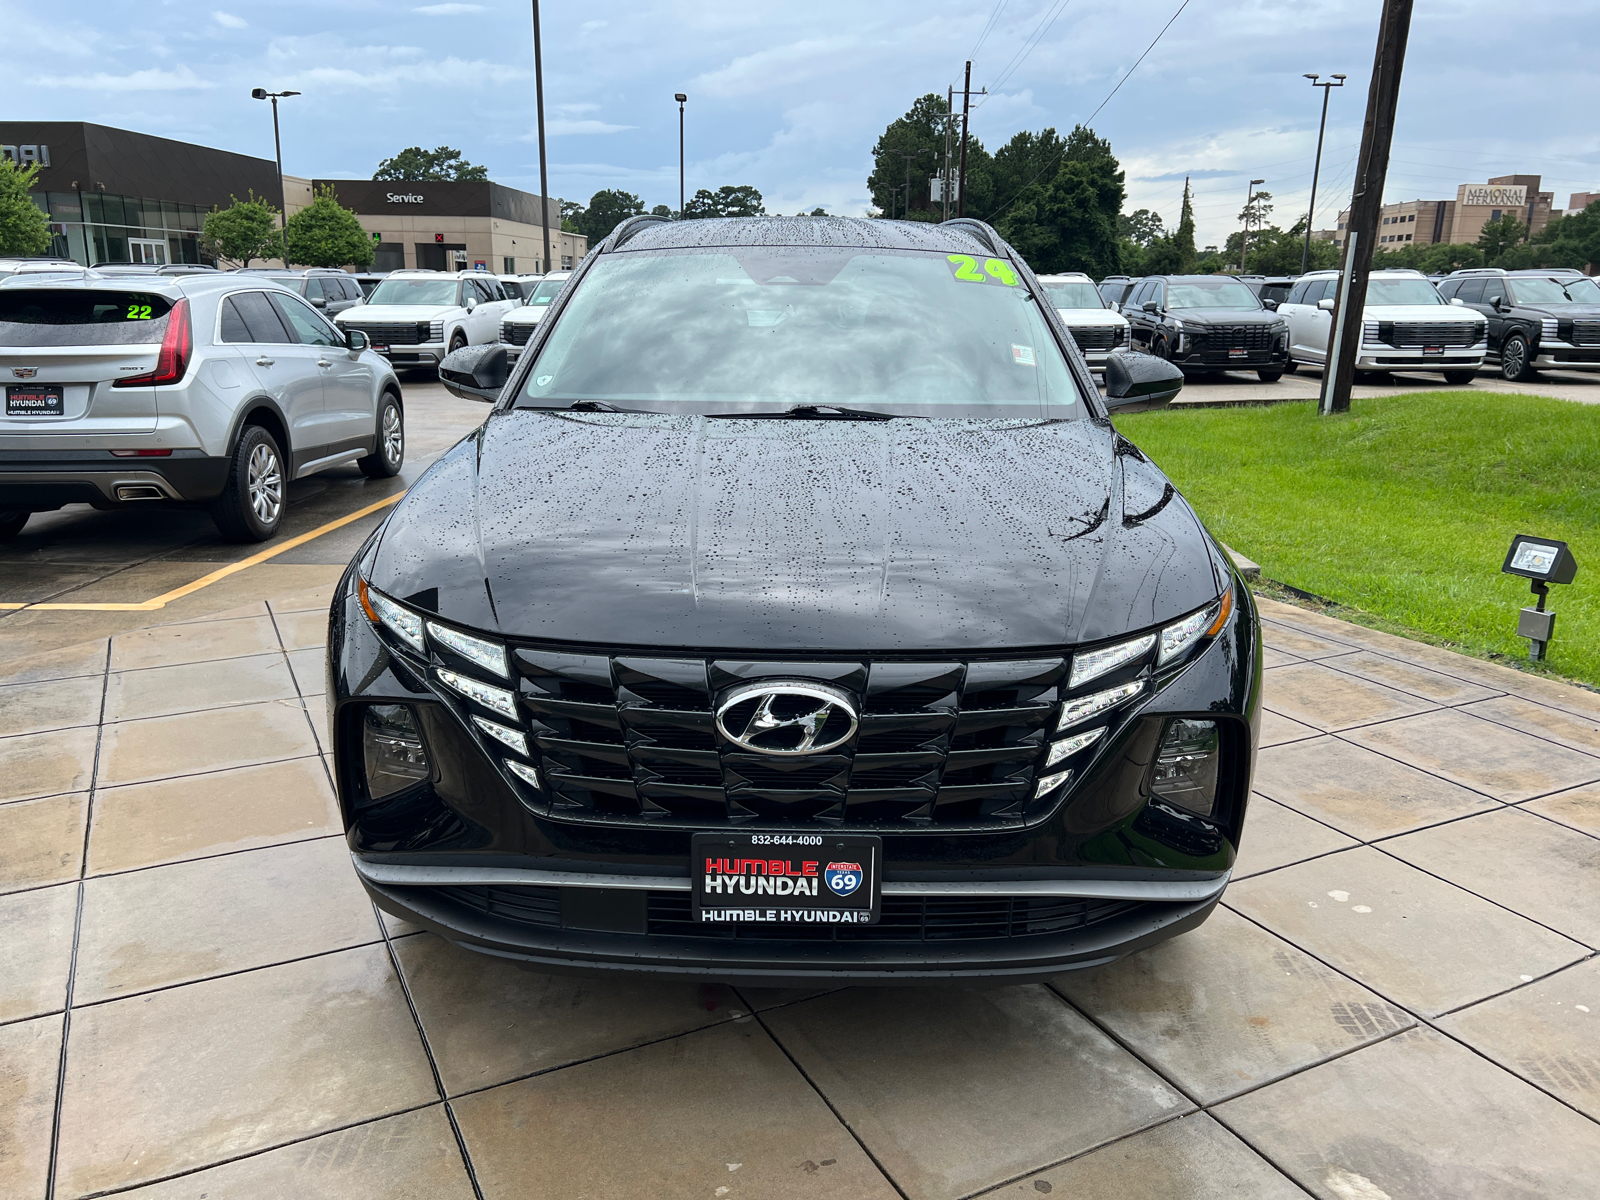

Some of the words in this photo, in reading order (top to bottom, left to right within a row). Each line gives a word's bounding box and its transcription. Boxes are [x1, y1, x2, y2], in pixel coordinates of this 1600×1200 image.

[386, 192, 424, 203] Service
[1468, 188, 1523, 198] MEMORIAL
[1467, 196, 1522, 205] HERMANN
[947, 254, 1019, 286] 24
[126, 304, 152, 320] 22
[751, 835, 823, 846] 832-644-4000
[705, 858, 819, 876] HUMBLE
[705, 874, 819, 896] HYUNDAI
[831, 874, 857, 890] 69
[702, 910, 777, 922] HUMBLE
[780, 910, 858, 923] HYUNDAI
